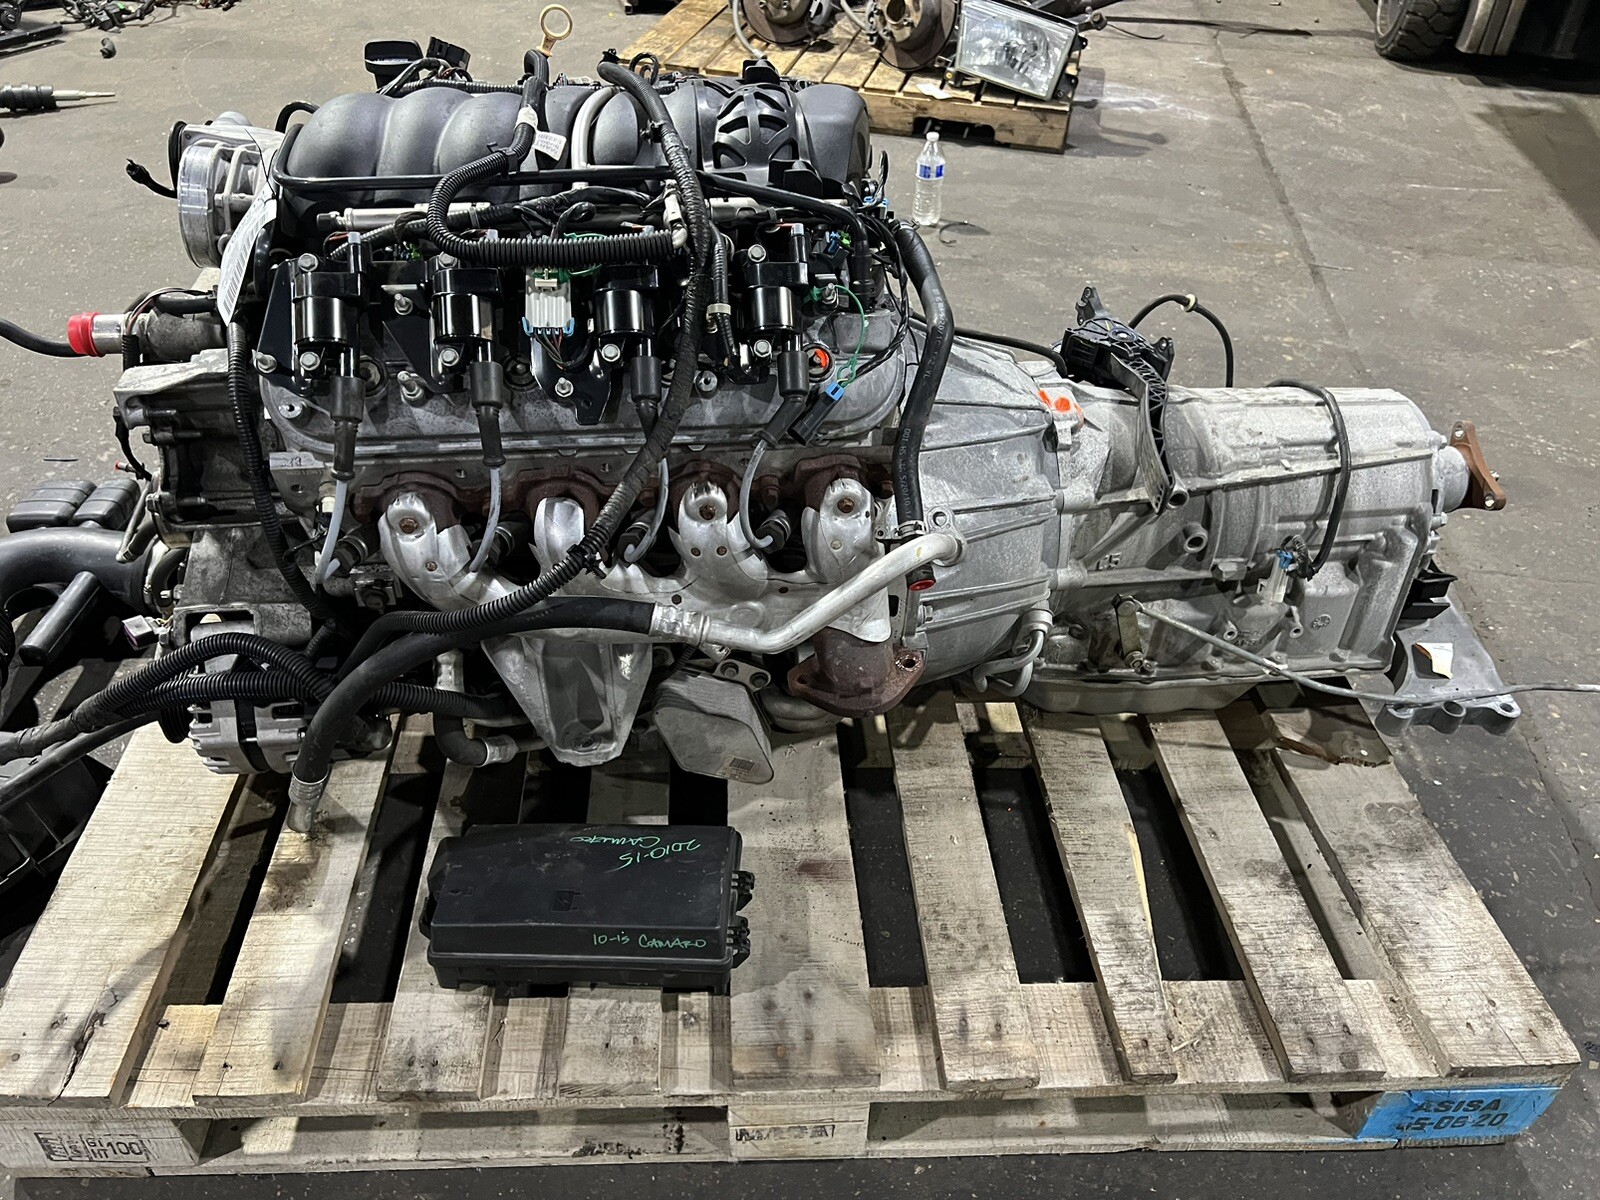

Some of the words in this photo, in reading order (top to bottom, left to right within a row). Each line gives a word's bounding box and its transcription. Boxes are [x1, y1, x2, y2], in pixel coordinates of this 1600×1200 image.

[603, 838, 701, 874] 2010-15
[1411, 1098, 1502, 1112] ASISA
[106, 1141, 143, 1156] 100
